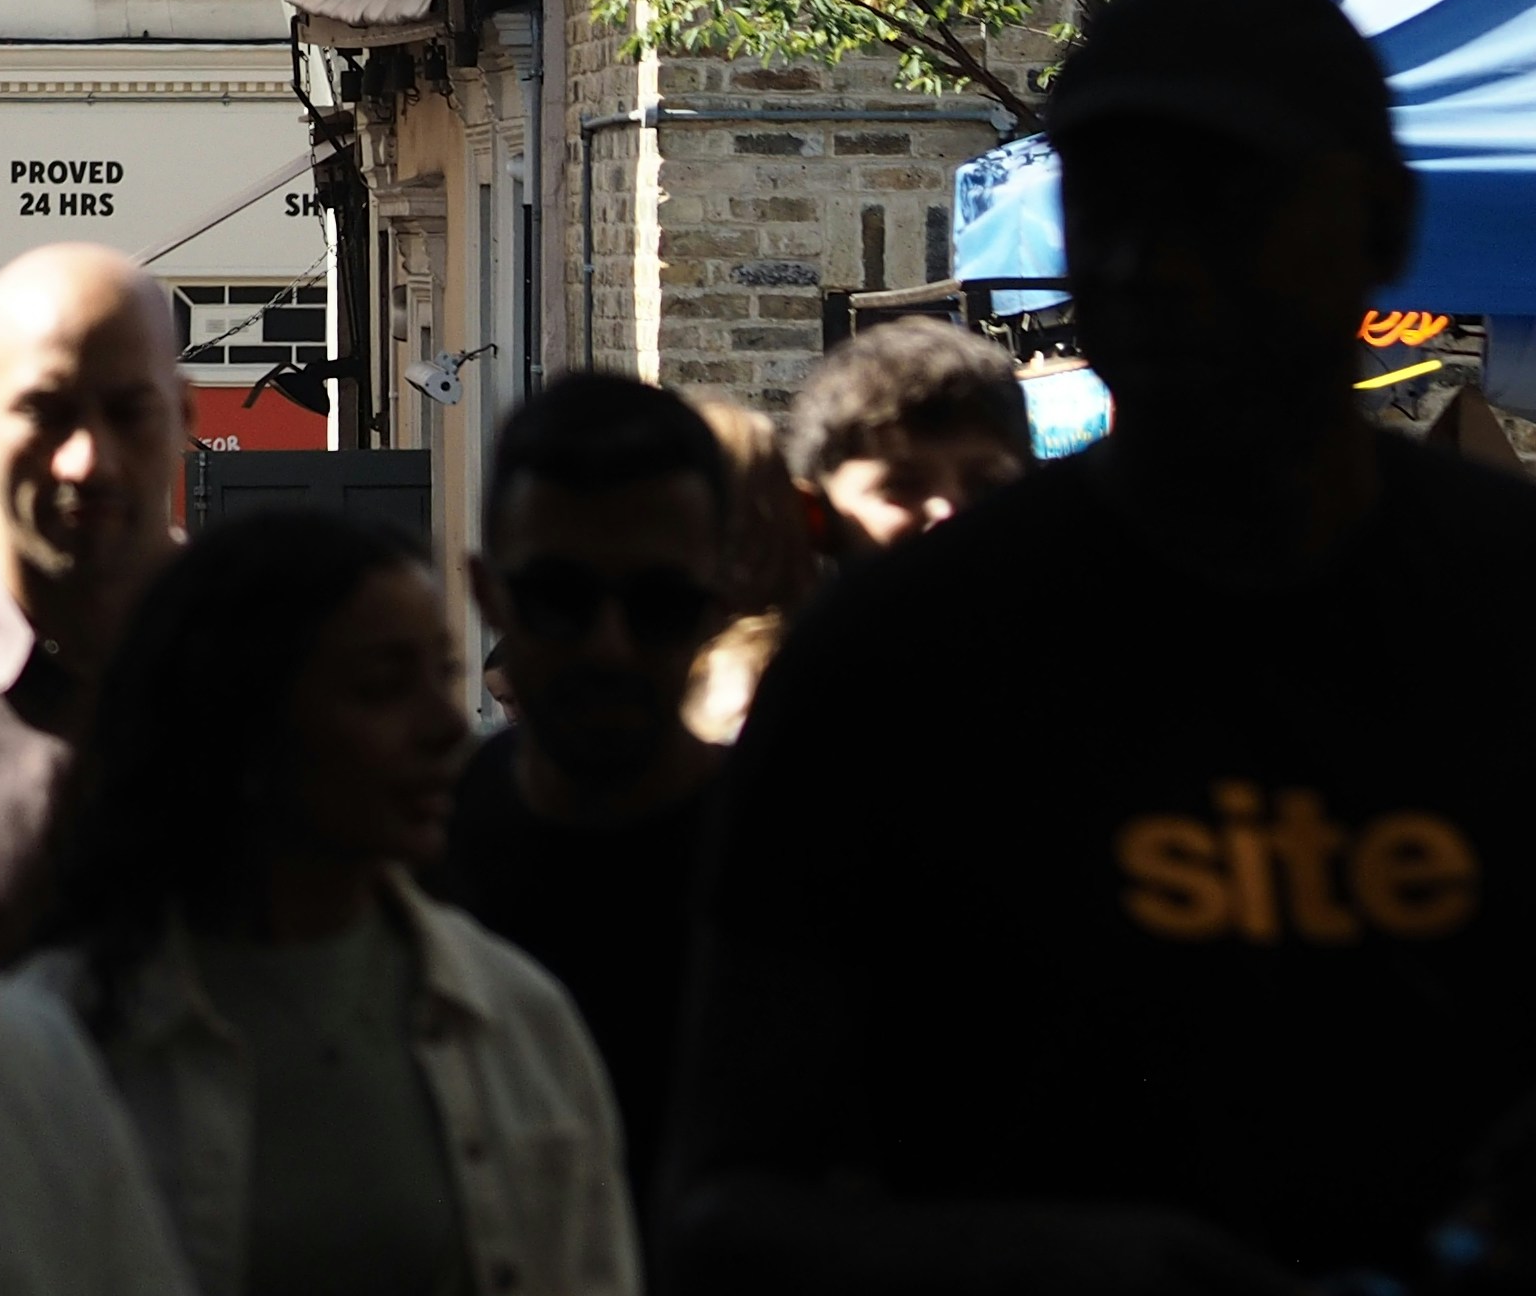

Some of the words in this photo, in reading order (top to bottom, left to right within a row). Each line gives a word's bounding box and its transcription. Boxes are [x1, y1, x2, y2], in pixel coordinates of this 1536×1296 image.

[9, 160, 124, 185] PROVED
[18, 192, 51, 217] 24
[59, 192, 115, 217] HRS
[1111, 774, 1483, 948] site
